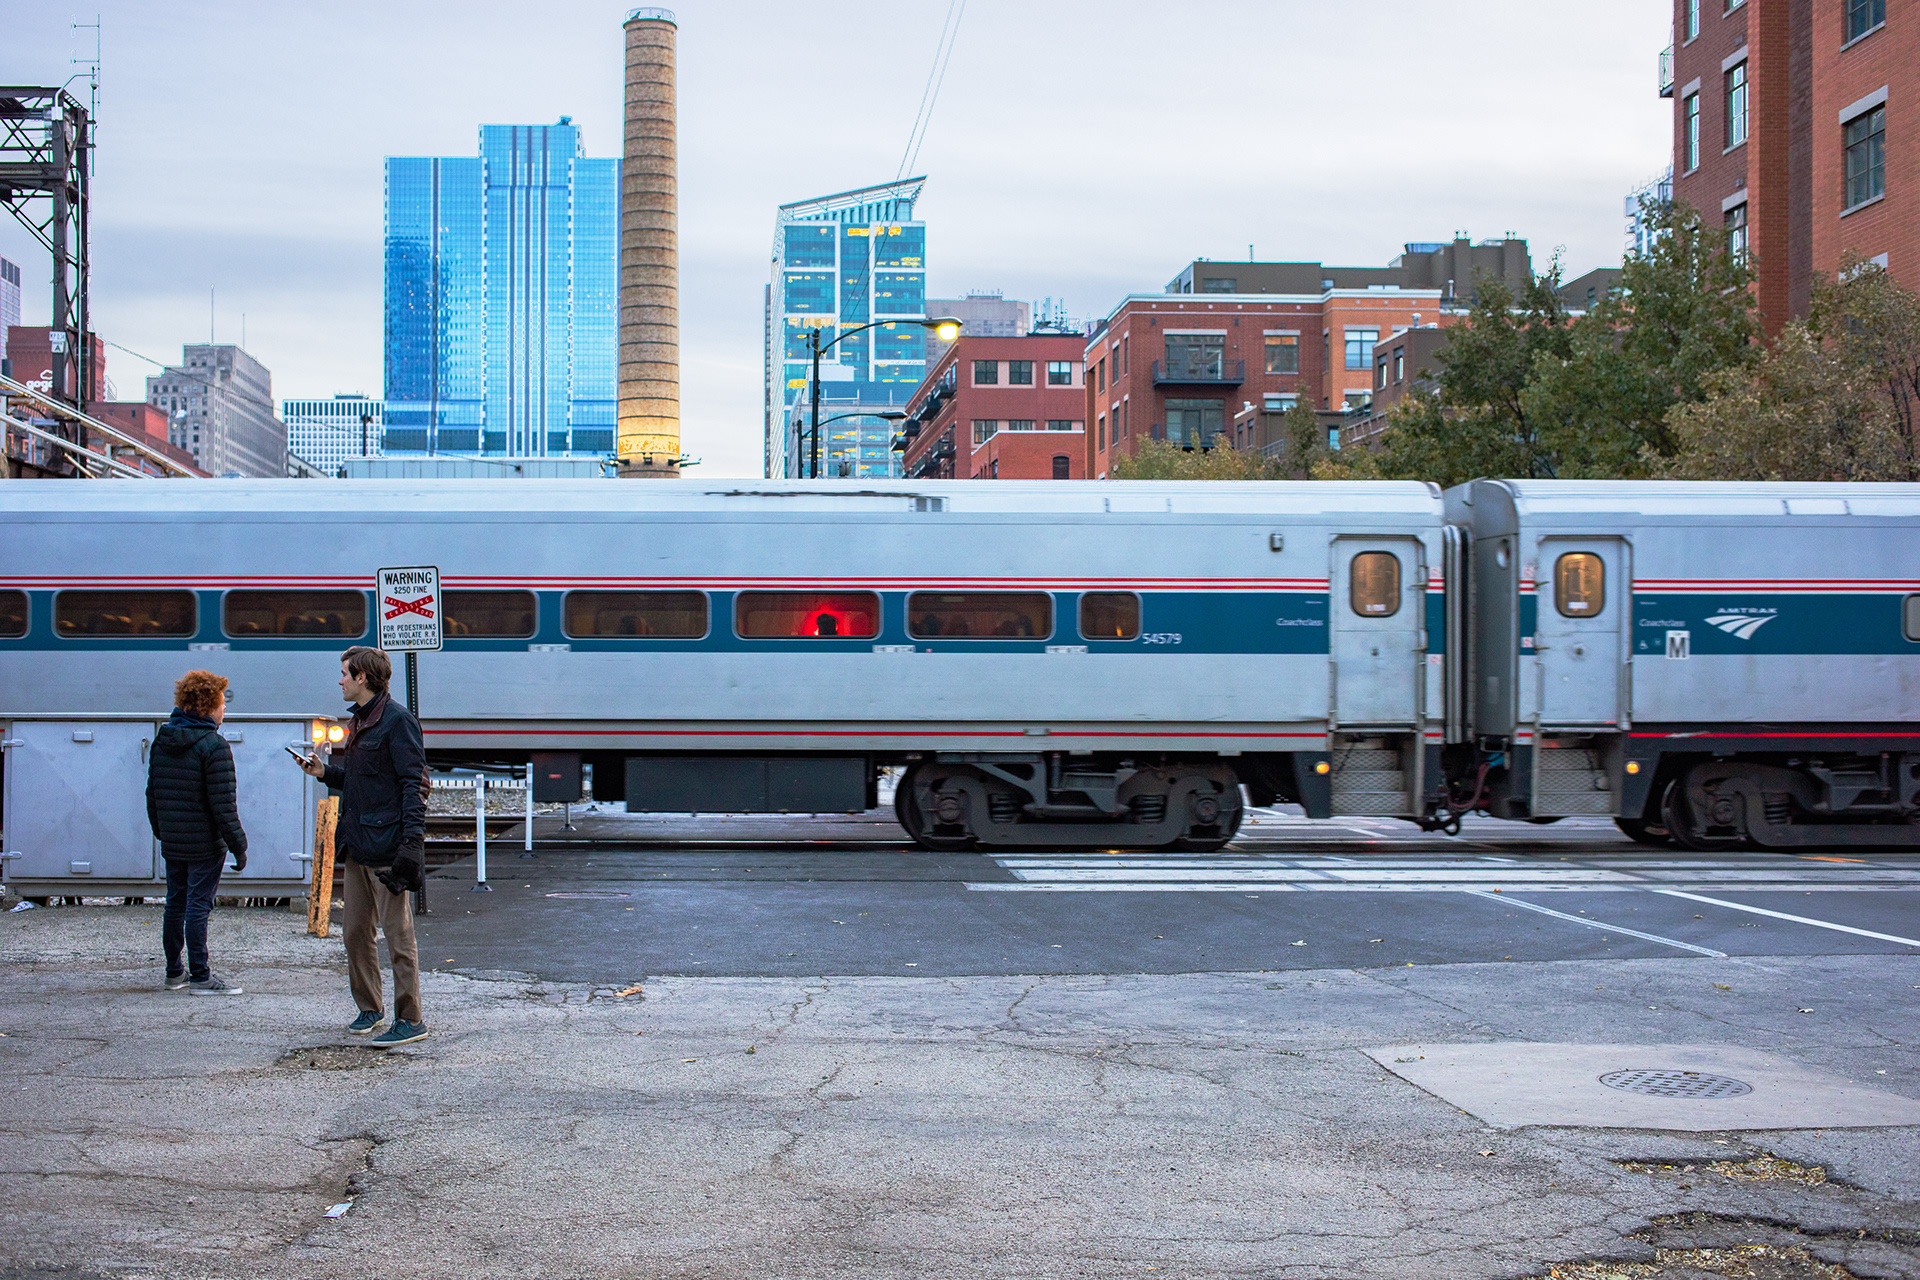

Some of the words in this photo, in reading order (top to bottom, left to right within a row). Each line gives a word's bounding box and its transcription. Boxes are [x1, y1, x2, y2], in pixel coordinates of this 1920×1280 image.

[384, 571, 432, 585] WARNING
[393, 586, 411, 594] $250
[413, 586, 428, 594] FINE
[397, 623, 437, 631] PEDESTRIANS
[398, 631, 422, 639] VIOLATE
[1142, 632, 1182, 644] 54579
[412, 638, 438, 646] DEVICES
[1669, 637, 1687, 658] M
